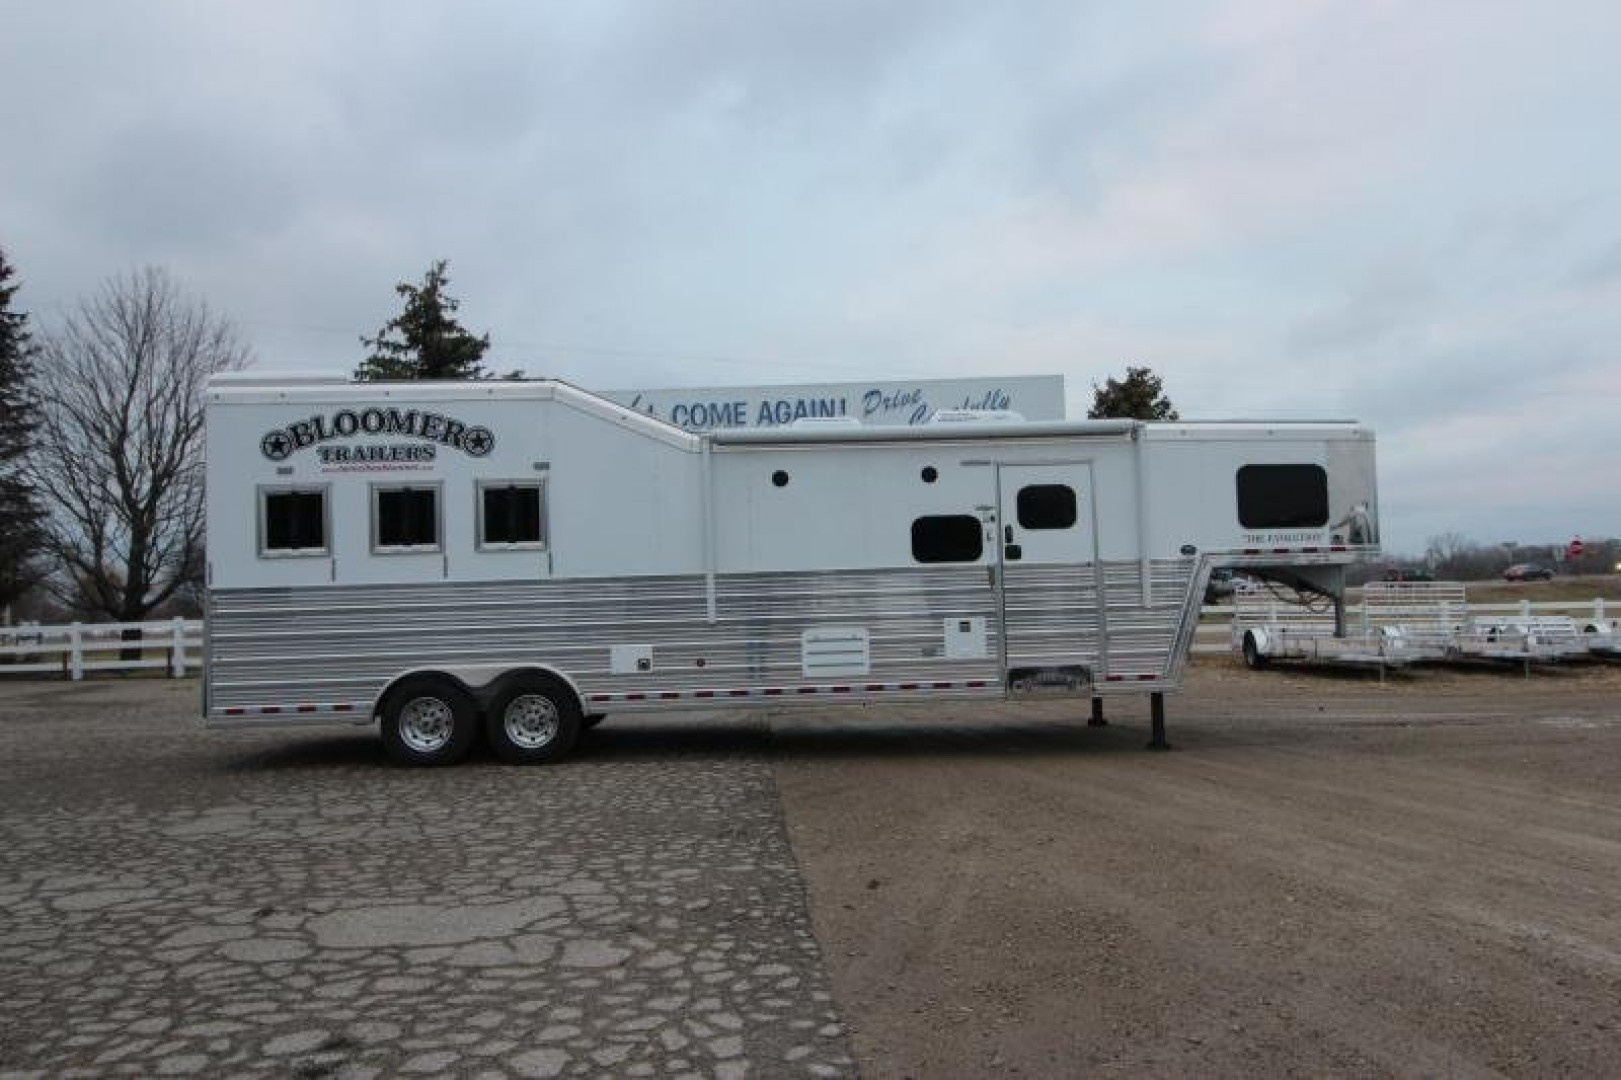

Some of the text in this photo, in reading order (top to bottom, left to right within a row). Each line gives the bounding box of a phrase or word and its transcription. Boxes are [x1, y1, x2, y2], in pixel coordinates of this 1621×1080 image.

[672, 401, 748, 427] COME
[862, 388, 922, 416] Drive
[287, 407, 466, 450] BLOOMER
[317, 444, 437, 463] TRAILERS
